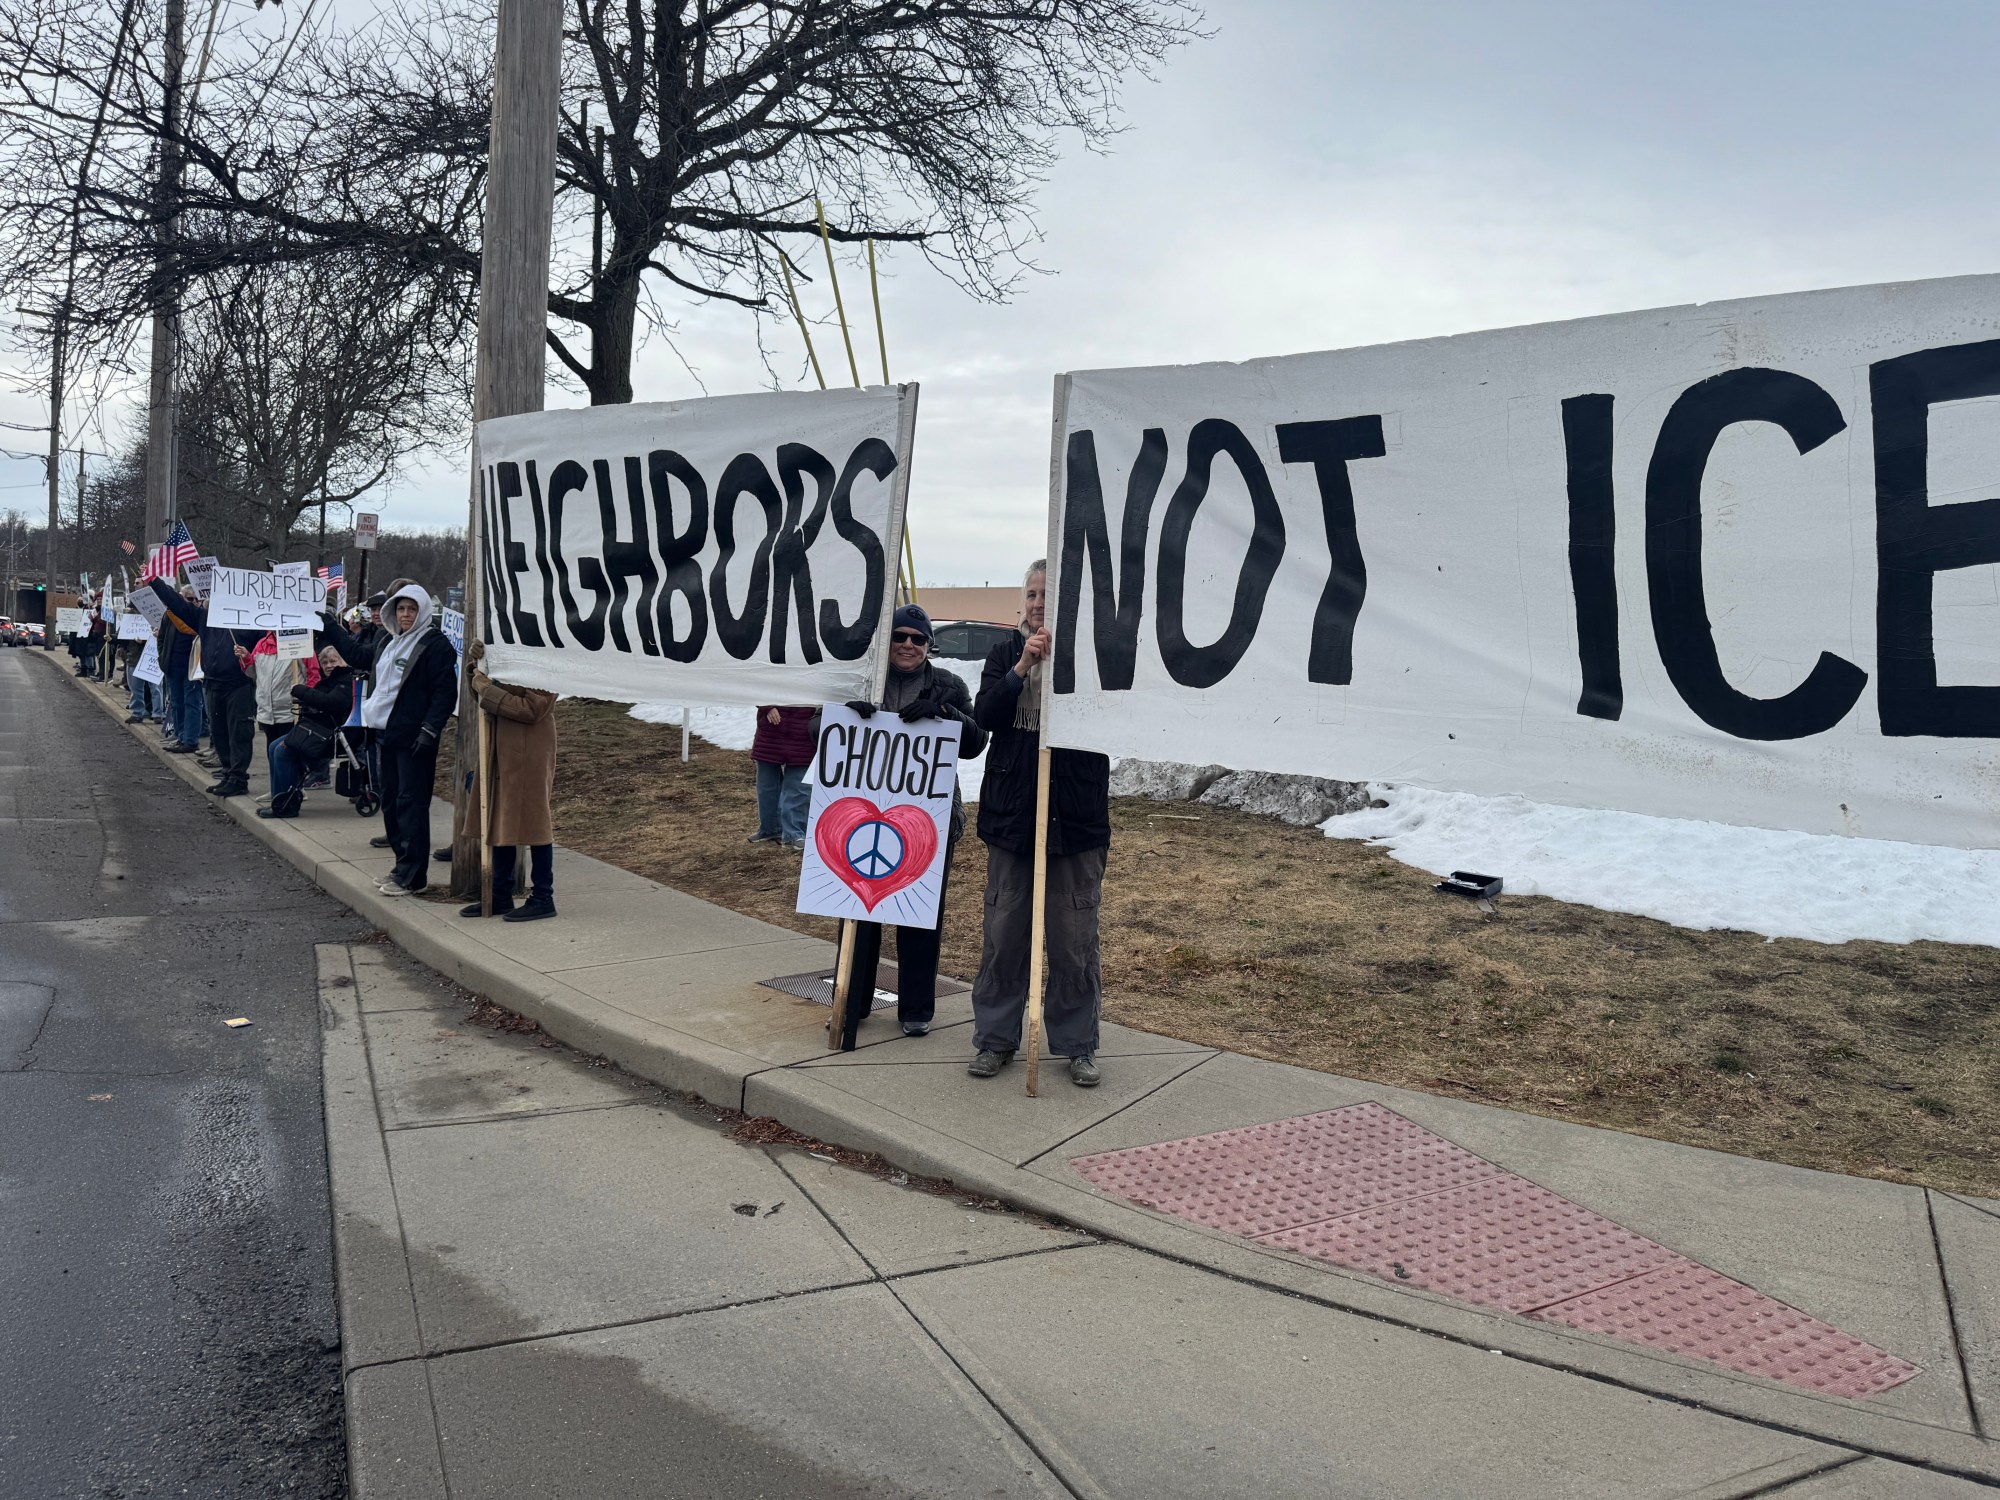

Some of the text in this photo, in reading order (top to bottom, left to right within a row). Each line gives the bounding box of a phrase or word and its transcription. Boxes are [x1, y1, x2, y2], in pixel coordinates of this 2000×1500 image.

[363, 516, 372, 524] NO
[480, 437, 899, 665] NEIGHBORS
[1053, 339, 2000, 741] NOT ICE
[213, 569, 326, 603] MURDERED
[222, 607, 302, 628] ICE
[257, 600, 273, 612] BY
[818, 722, 957, 799] CHOOSE
